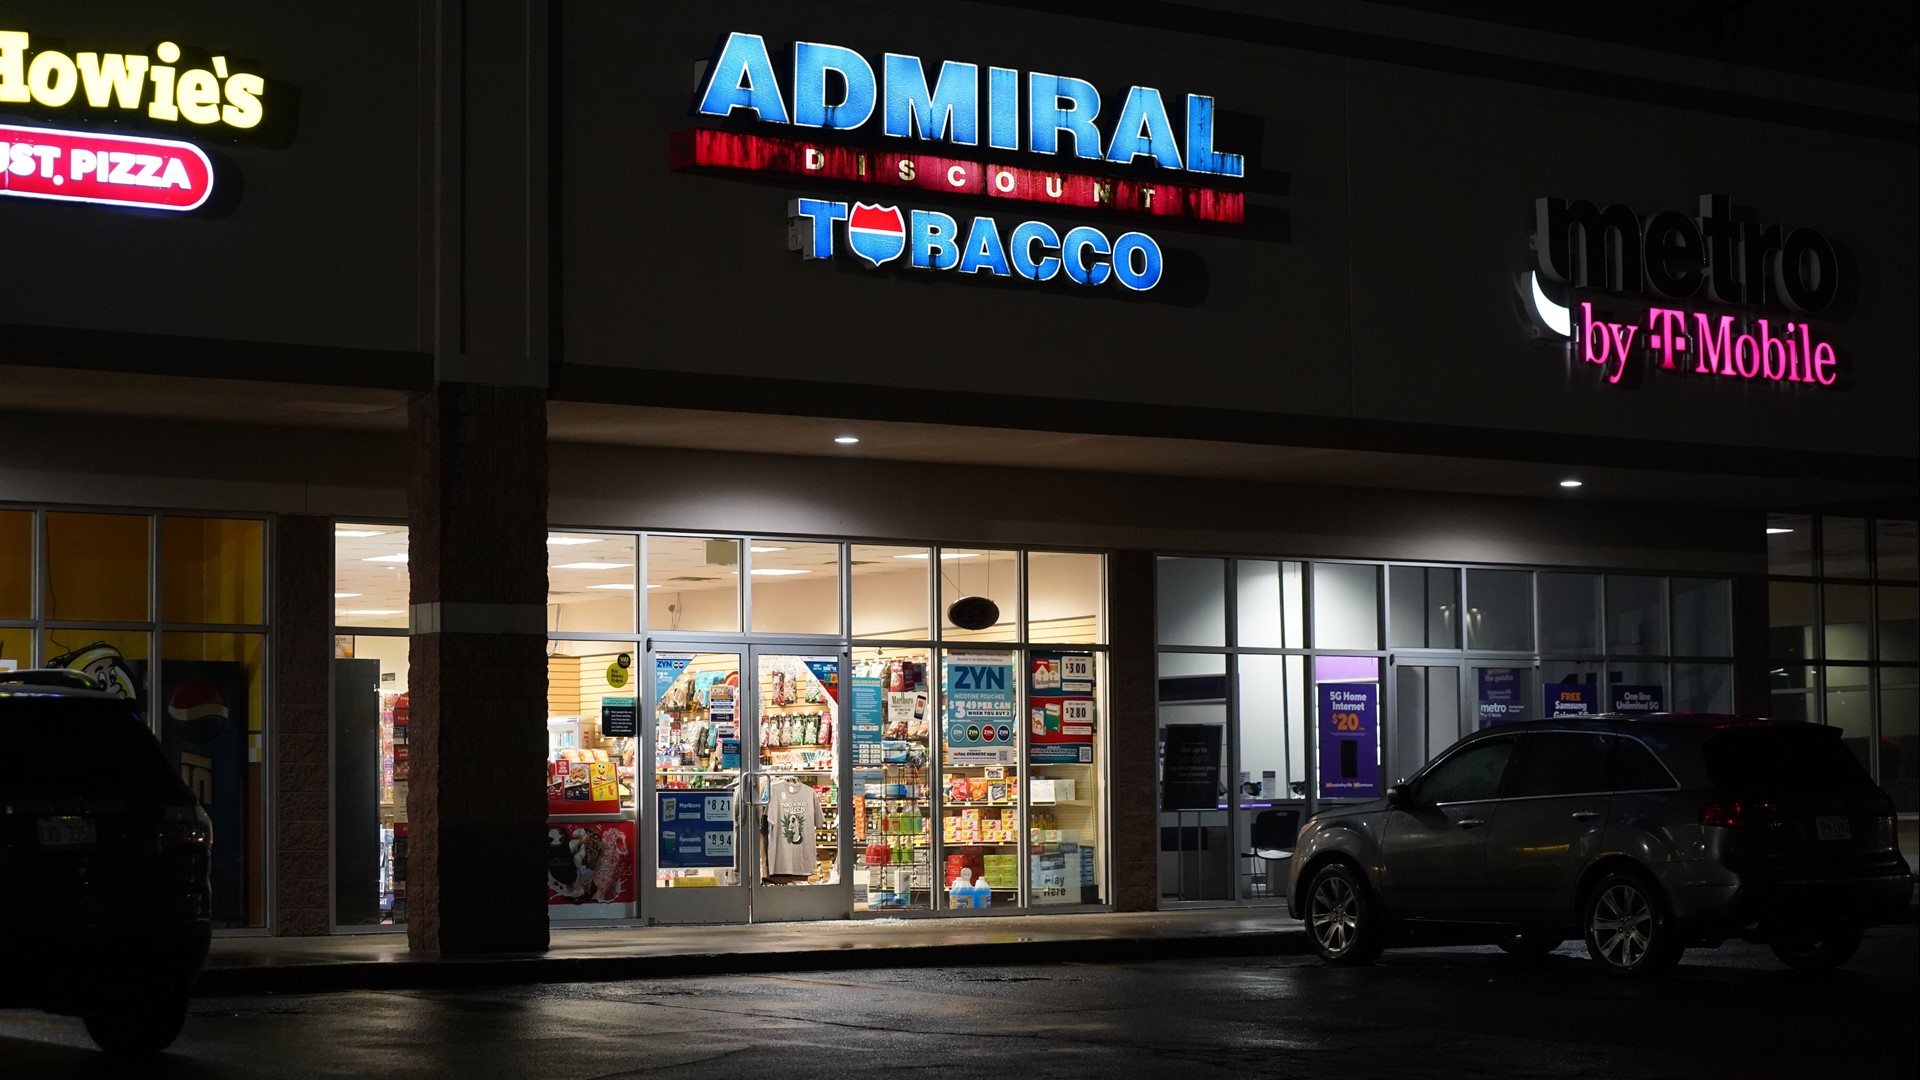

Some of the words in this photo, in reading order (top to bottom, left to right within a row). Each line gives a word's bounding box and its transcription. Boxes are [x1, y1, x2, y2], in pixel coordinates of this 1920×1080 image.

[698, 32, 1244, 178] ADMIRAL
[70, 149, 191, 190] PIZZA
[805, 148, 1156, 209] DISCOUNT
[1537, 193, 1839, 313] metro
[1581, 302, 1637, 383] by
[1693, 312, 1836, 385] Mobile
[955, 666, 1004, 689] ZYN
[1329, 691, 1342, 701] 5G
[1343, 691, 1367, 702] Home
[1561, 692, 1581, 701] FREE
[1624, 691, 1638, 700] One
[977, 701, 992, 710] PER
[994, 702, 1011, 710] CAN
[1332, 701, 1365, 711] Internet
[1480, 703, 1506, 713] metro
[1554, 700, 1587, 711] Samsung
[1616, 701, 1648, 710] Unlimited
[1332, 713, 1359, 731] $20
